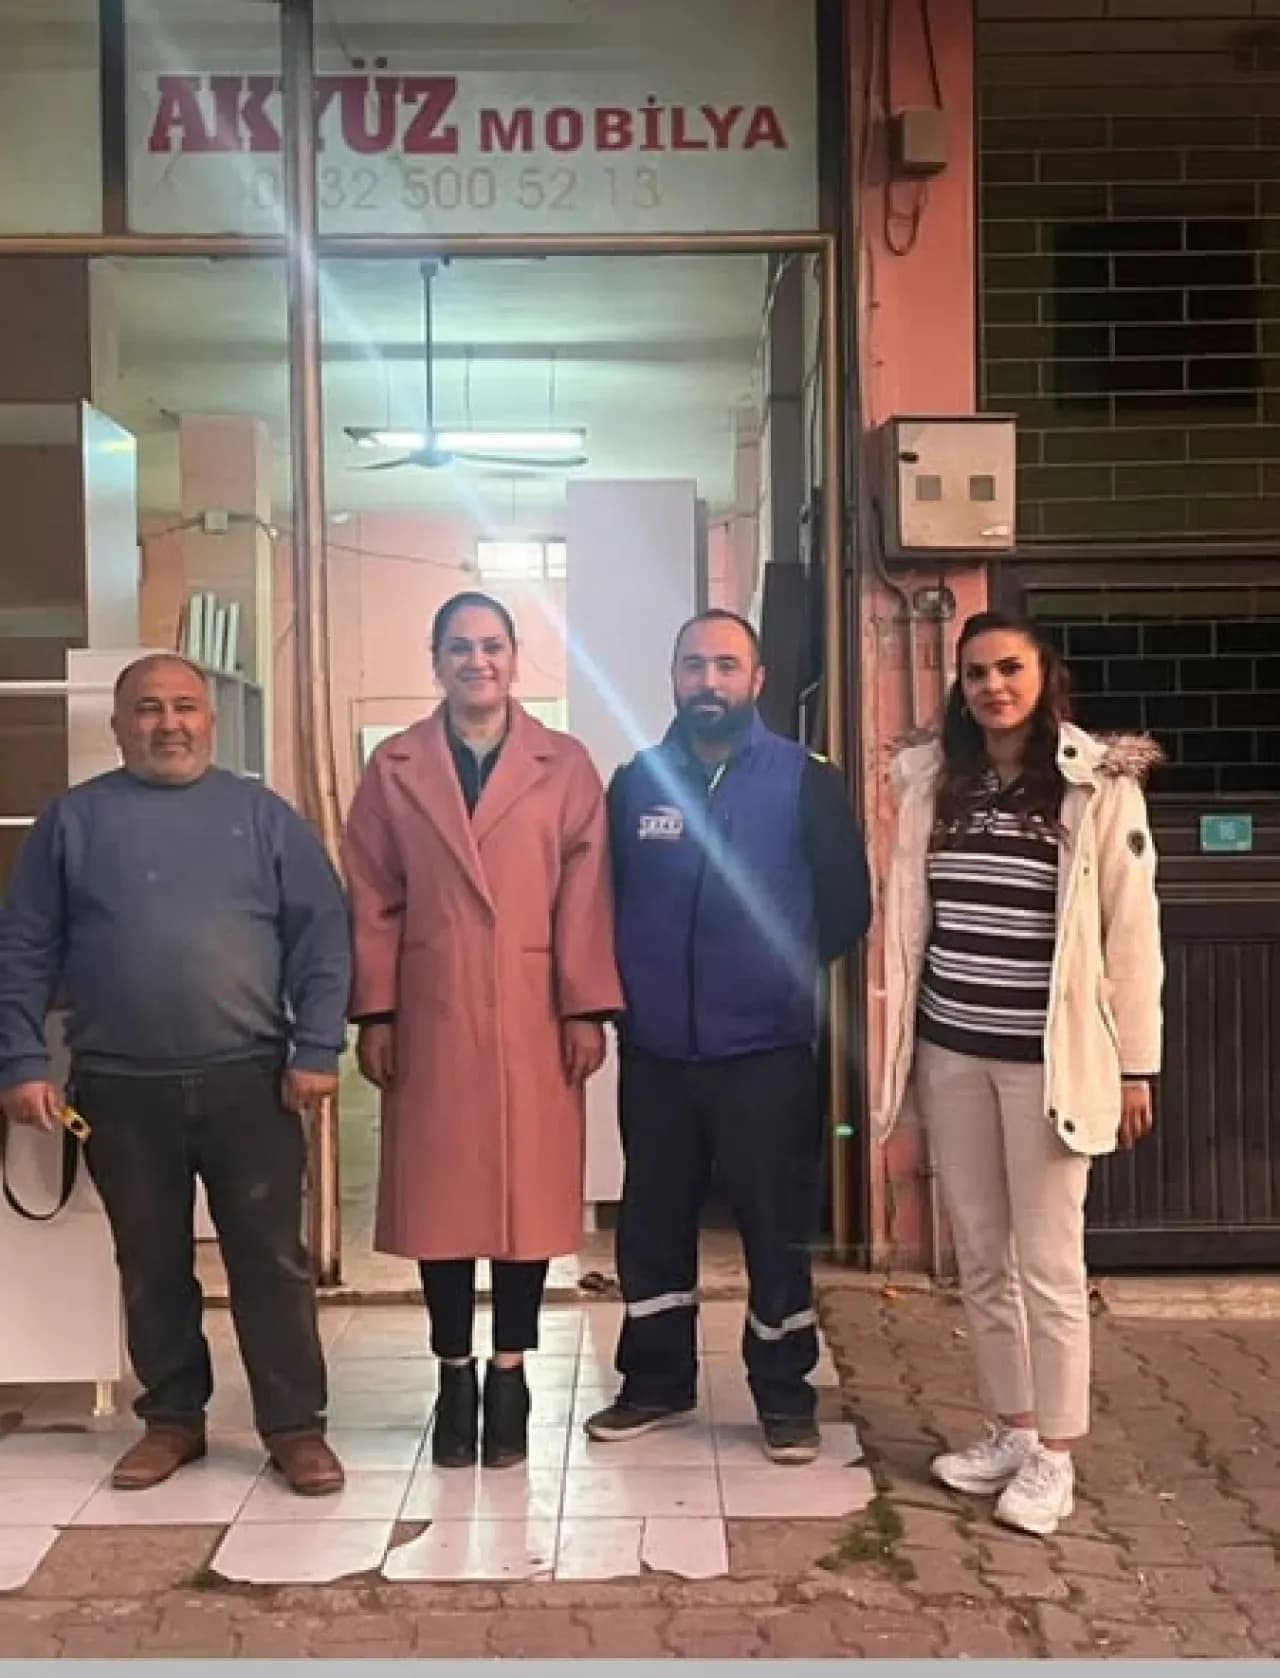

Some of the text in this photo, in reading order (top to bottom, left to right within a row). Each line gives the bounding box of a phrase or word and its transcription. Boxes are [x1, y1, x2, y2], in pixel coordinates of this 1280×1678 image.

[479, 94, 788, 152] MOBİLYA
[254, 165, 660, 210] 032 500 52 13
